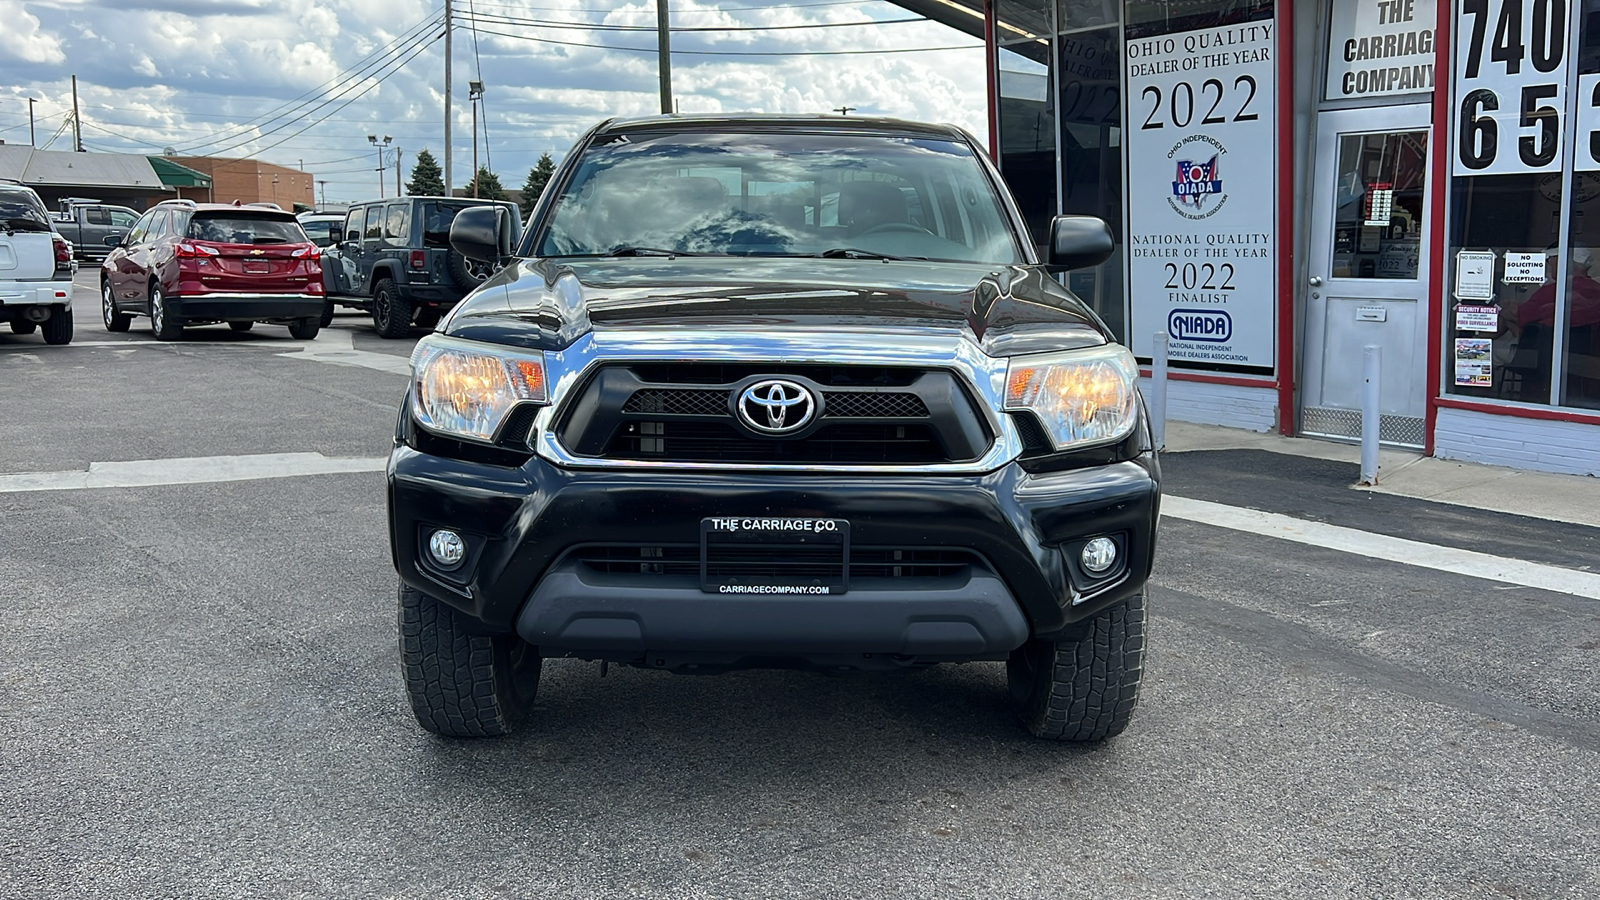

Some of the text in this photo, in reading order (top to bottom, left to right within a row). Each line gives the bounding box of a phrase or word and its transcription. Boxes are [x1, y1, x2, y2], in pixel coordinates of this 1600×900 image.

[1377, 1, 1414, 25] THE
[1128, 38, 1175, 59] OHIO
[1184, 24, 1272, 54] QUALITY
[1463, 0, 1566, 79] 740
[1130, 58, 1179, 77] DEALER
[1182, 56, 1199, 71] OF
[1201, 52, 1230, 68] THE
[1232, 46, 1270, 65] YEAR
[1342, 63, 1435, 95] COMPANY
[1140, 74, 1259, 130] 2022
[1167, 134, 1228, 159] OHIO INDEPENDENT
[1177, 181, 1214, 195] OIADA
[1166, 196, 1188, 219] AUTOMOBILE
[1132, 233, 1270, 246] NATIONAL QUALITY
[1134, 248, 1268, 258] DEALER OF THE YEAR
[1164, 262, 1236, 291] 2022
[1169, 292, 1229, 304] FINALIST
[1172, 315, 1226, 337] NIADA
[1196, 344, 1232, 352] INDEPENDENT
[1211, 354, 1249, 362] ASSOCIATION
[712, 519, 839, 531] THE CARRIAGE CO.
[719, 585, 830, 595] CARRIAGECOMPANY.COM
